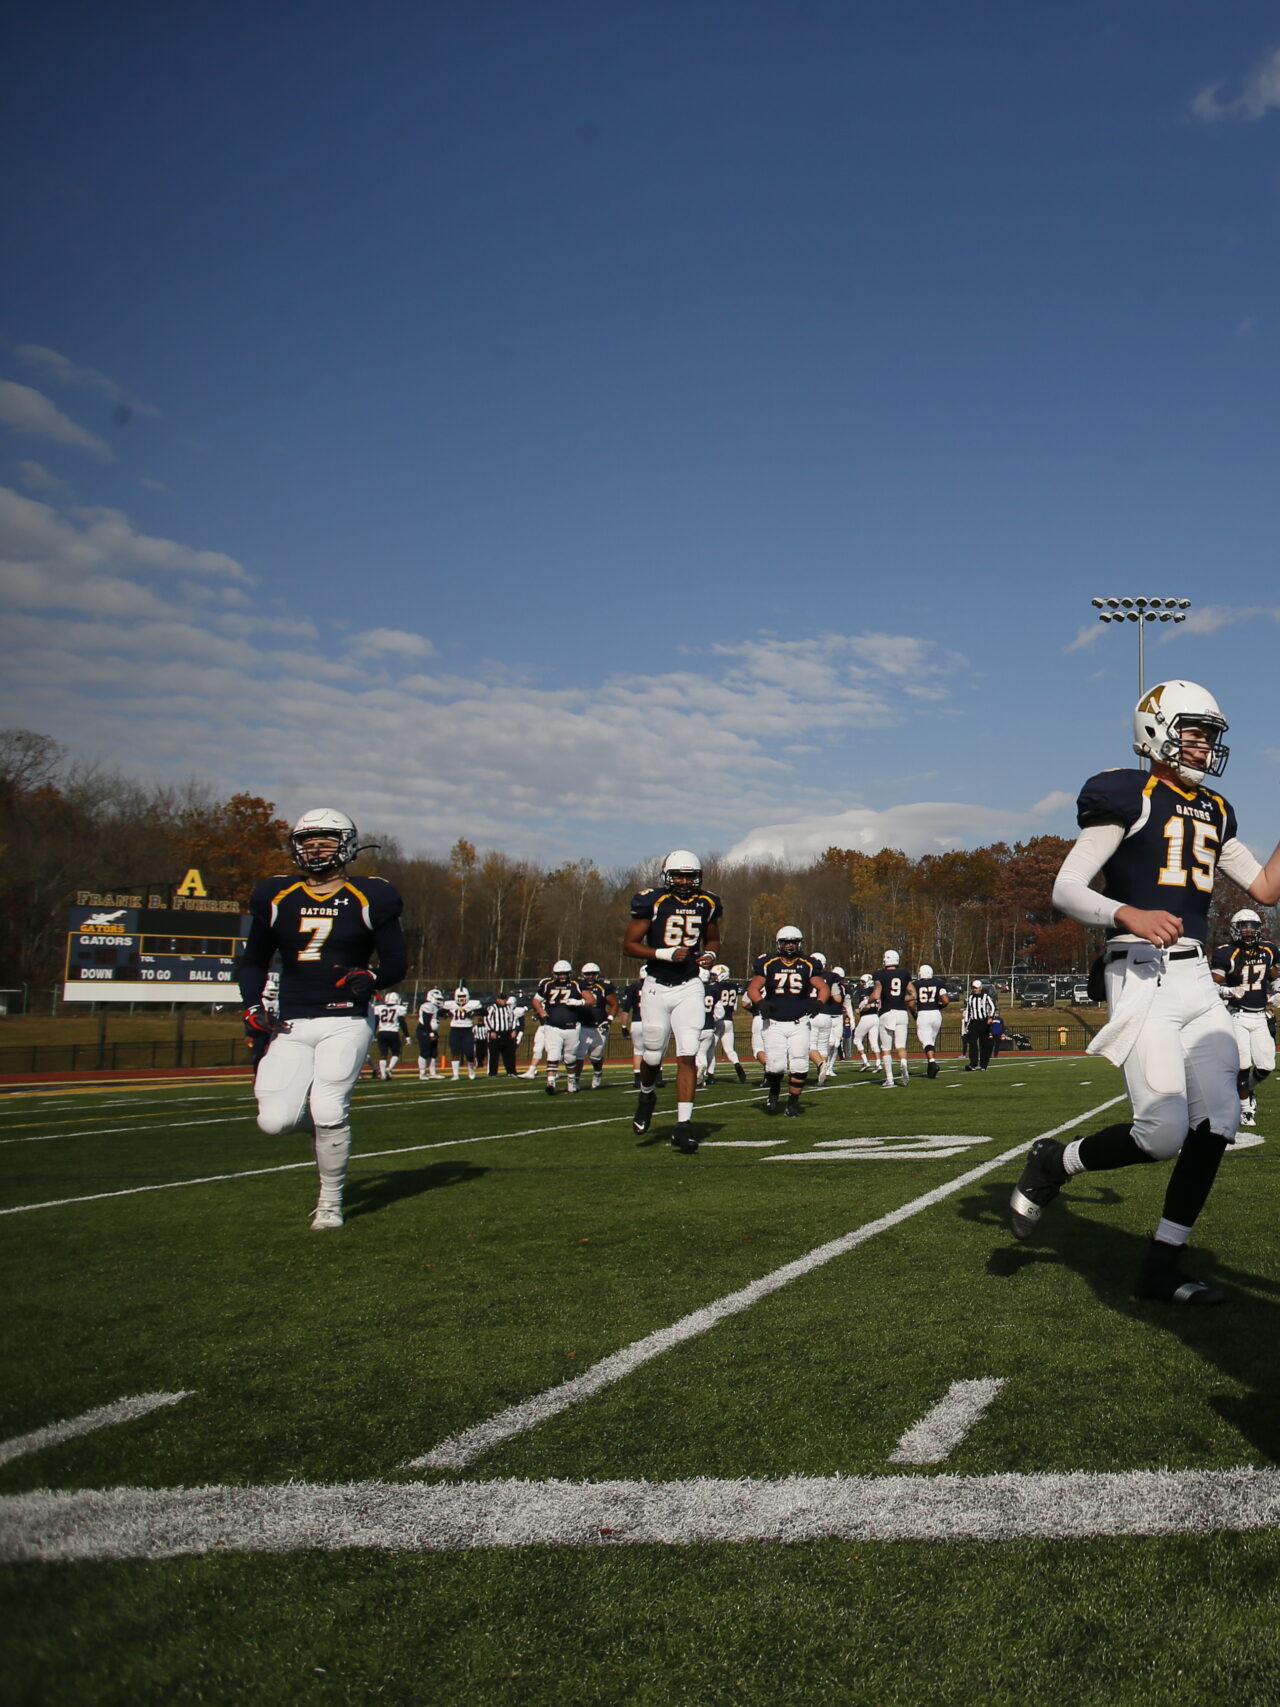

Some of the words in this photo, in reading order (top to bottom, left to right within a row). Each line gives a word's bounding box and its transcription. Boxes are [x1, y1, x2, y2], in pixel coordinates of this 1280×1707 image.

[1176, 804, 1211, 822] GATORS
[1157, 815, 1220, 893] 15
[176, 868, 207, 897] A
[76, 891, 142, 908] FRANK
[148, 894, 167, 909] B.
[300, 907, 339, 916] GATORS
[80, 924, 126, 933] GATORS
[664, 915, 702, 947] 65
[80, 935, 133, 946] GATORS
[297, 917, 334, 962] 7
[81, 968, 113, 979] DOWN
[141, 970, 155, 980] TO
[156, 970, 171, 980] GO
[189, 970, 213, 981] BALL
[217, 971, 232, 981] ON
[1240, 964, 1266, 991] 17
[891, 977, 902, 996] 9
[918, 986, 937, 1003] 67
[549, 989, 572, 1004] 77
[720, 989, 737, 1006] 92
[380, 1009, 396, 1023] 27
